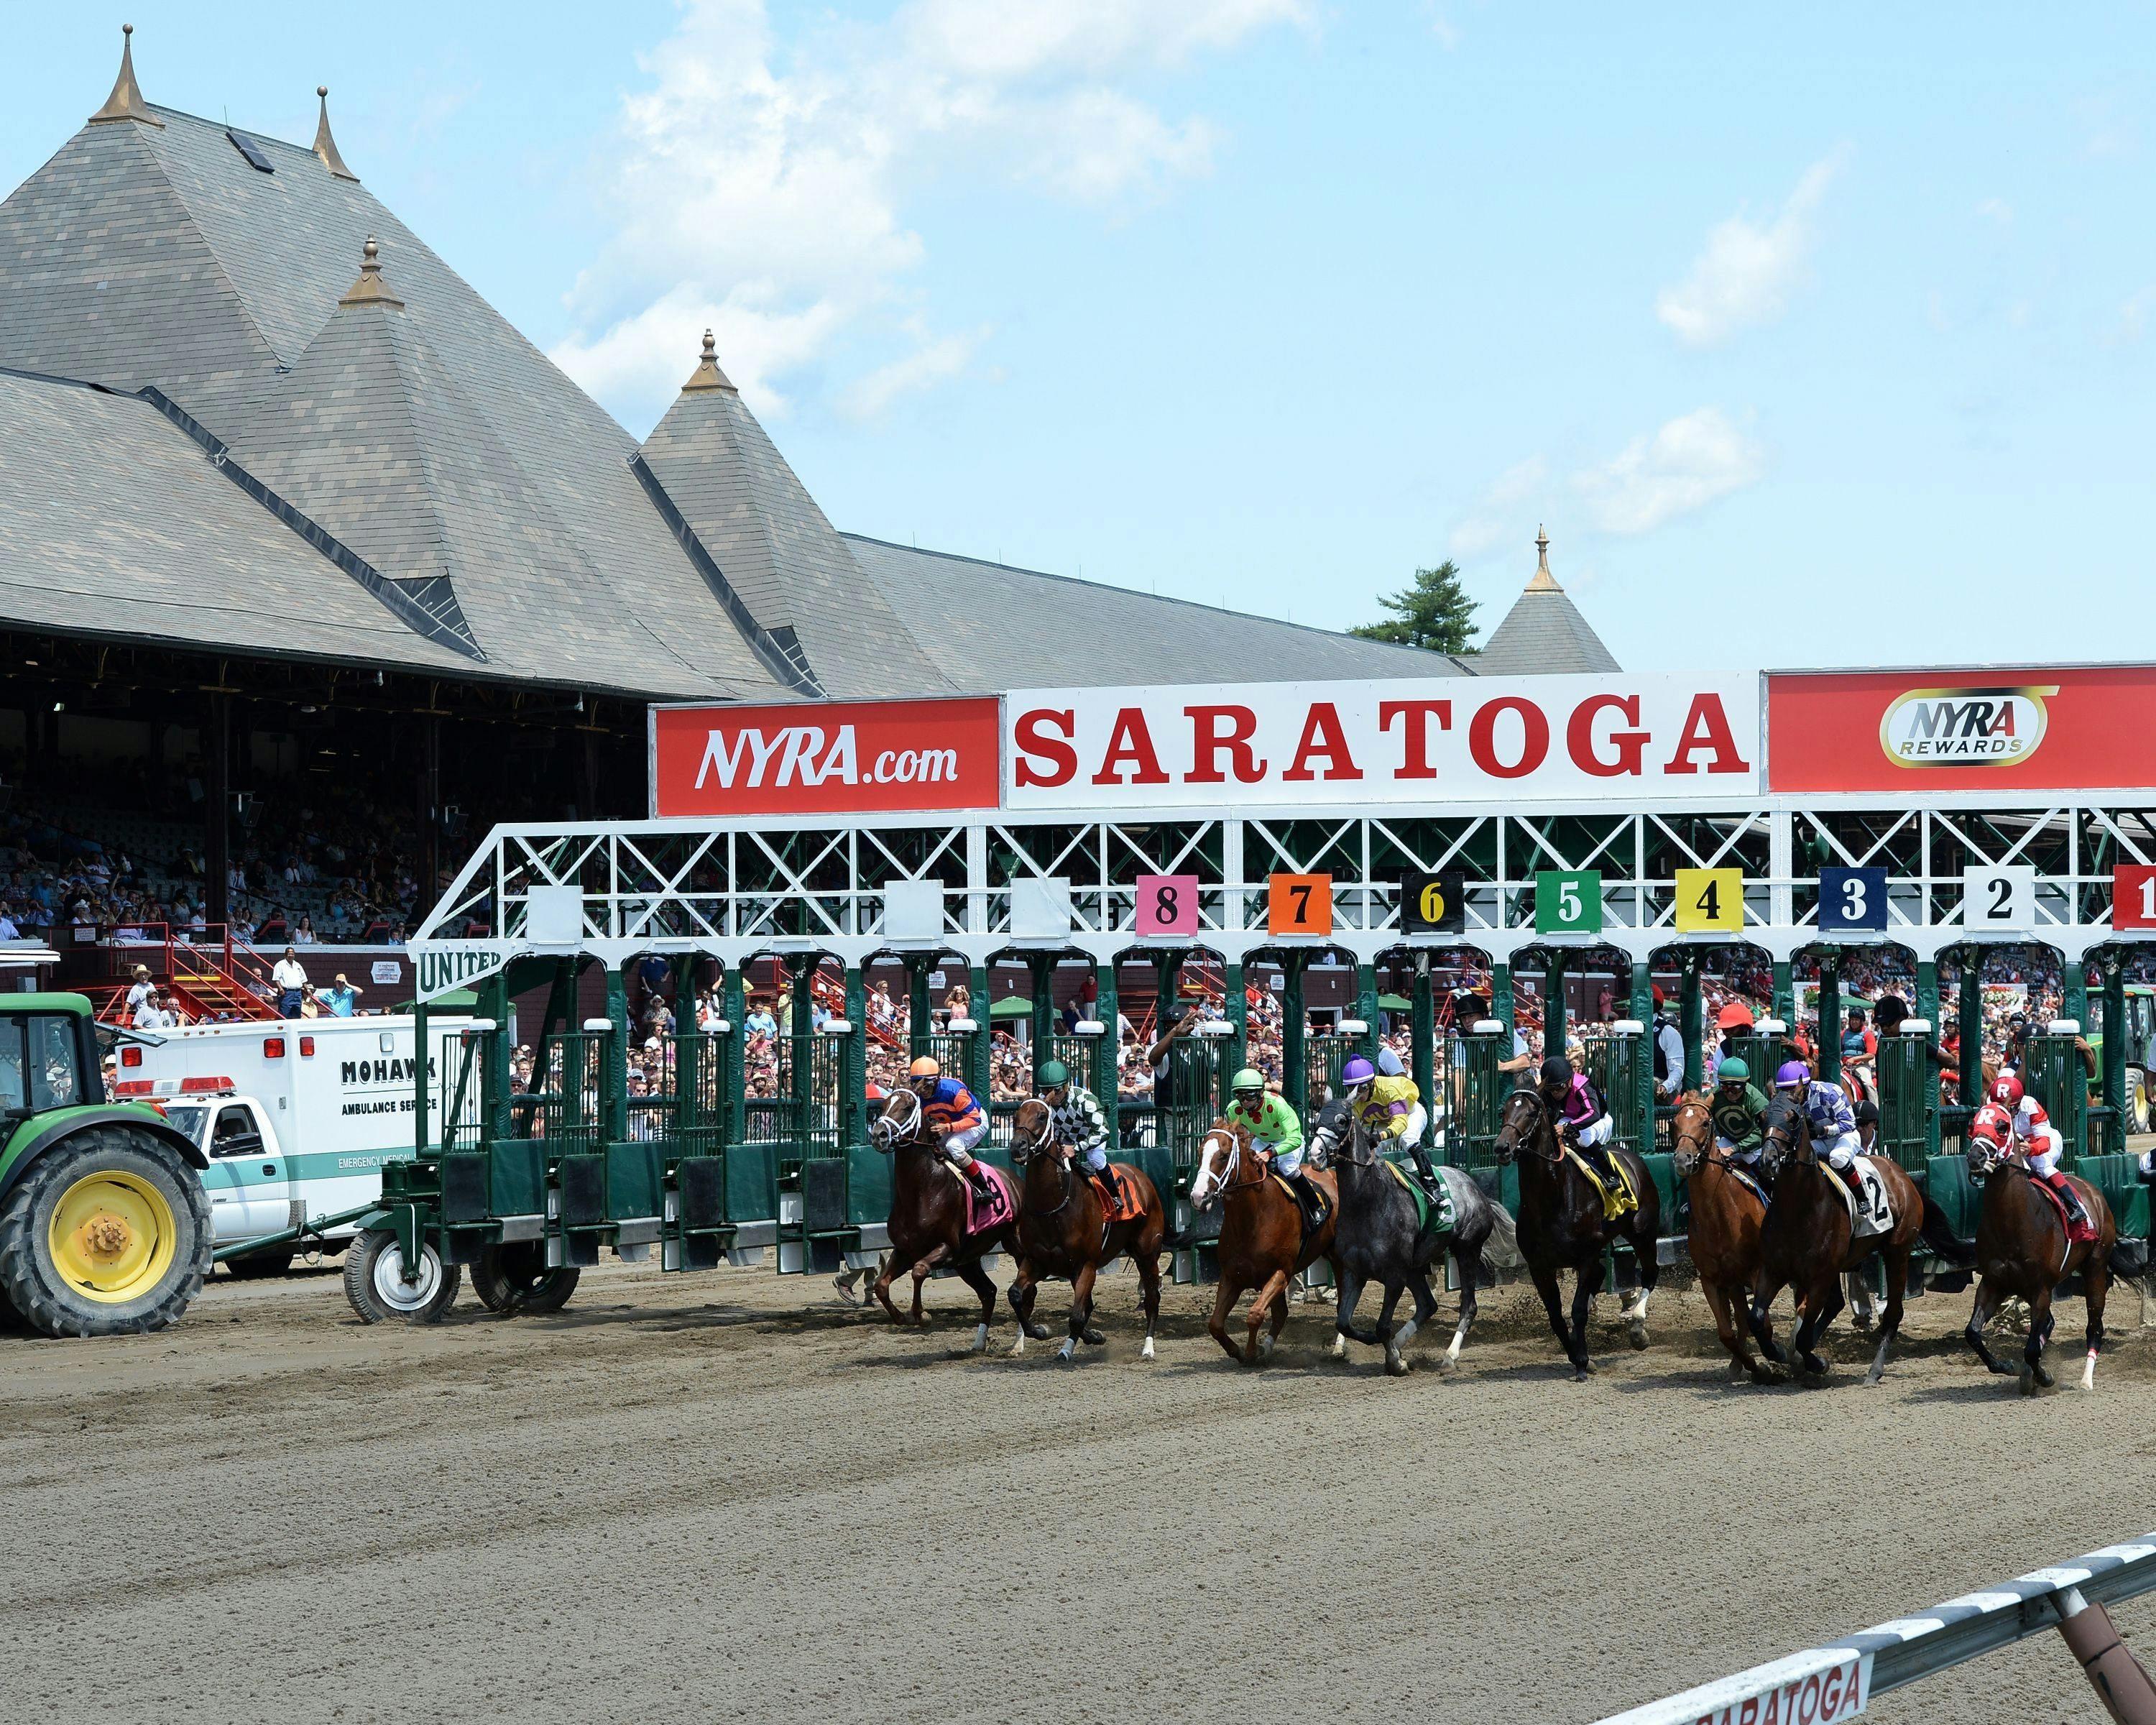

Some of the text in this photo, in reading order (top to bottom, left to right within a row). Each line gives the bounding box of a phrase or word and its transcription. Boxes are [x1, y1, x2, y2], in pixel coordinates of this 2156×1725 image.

[1015, 693, 1750, 787] SARATOGA
[1908, 701, 2015, 738] NYRA
[695, 724, 958, 789] NYRA.com
[1899, 739, 2023, 755] REWARDS
[1155, 886, 1178, 924] 8
[1289, 885, 1312, 924] 7
[1420, 882, 1445, 923] 6
[1557, 880, 1583, 922] 5
[1696, 880, 1720, 920] 4
[1841, 878, 1866, 921] 3
[1987, 878, 2012, 919] 2
[2138, 876, 2156, 919] 1
[419, 952, 501, 993] UNITED
[341, 1098, 437, 1116] AMBULANCE SERCE
[1996, 1083, 2010, 1098] R
[1976, 1108, 1996, 1126] R
[338, 1156, 381, 1169] EMERGENCY
[987, 1175, 1006, 1216] 8
[1115, 1174, 1135, 1214] 7
[1866, 1175, 1888, 1223] 2
[1693, 1661, 1860, 1725] RATOGA
